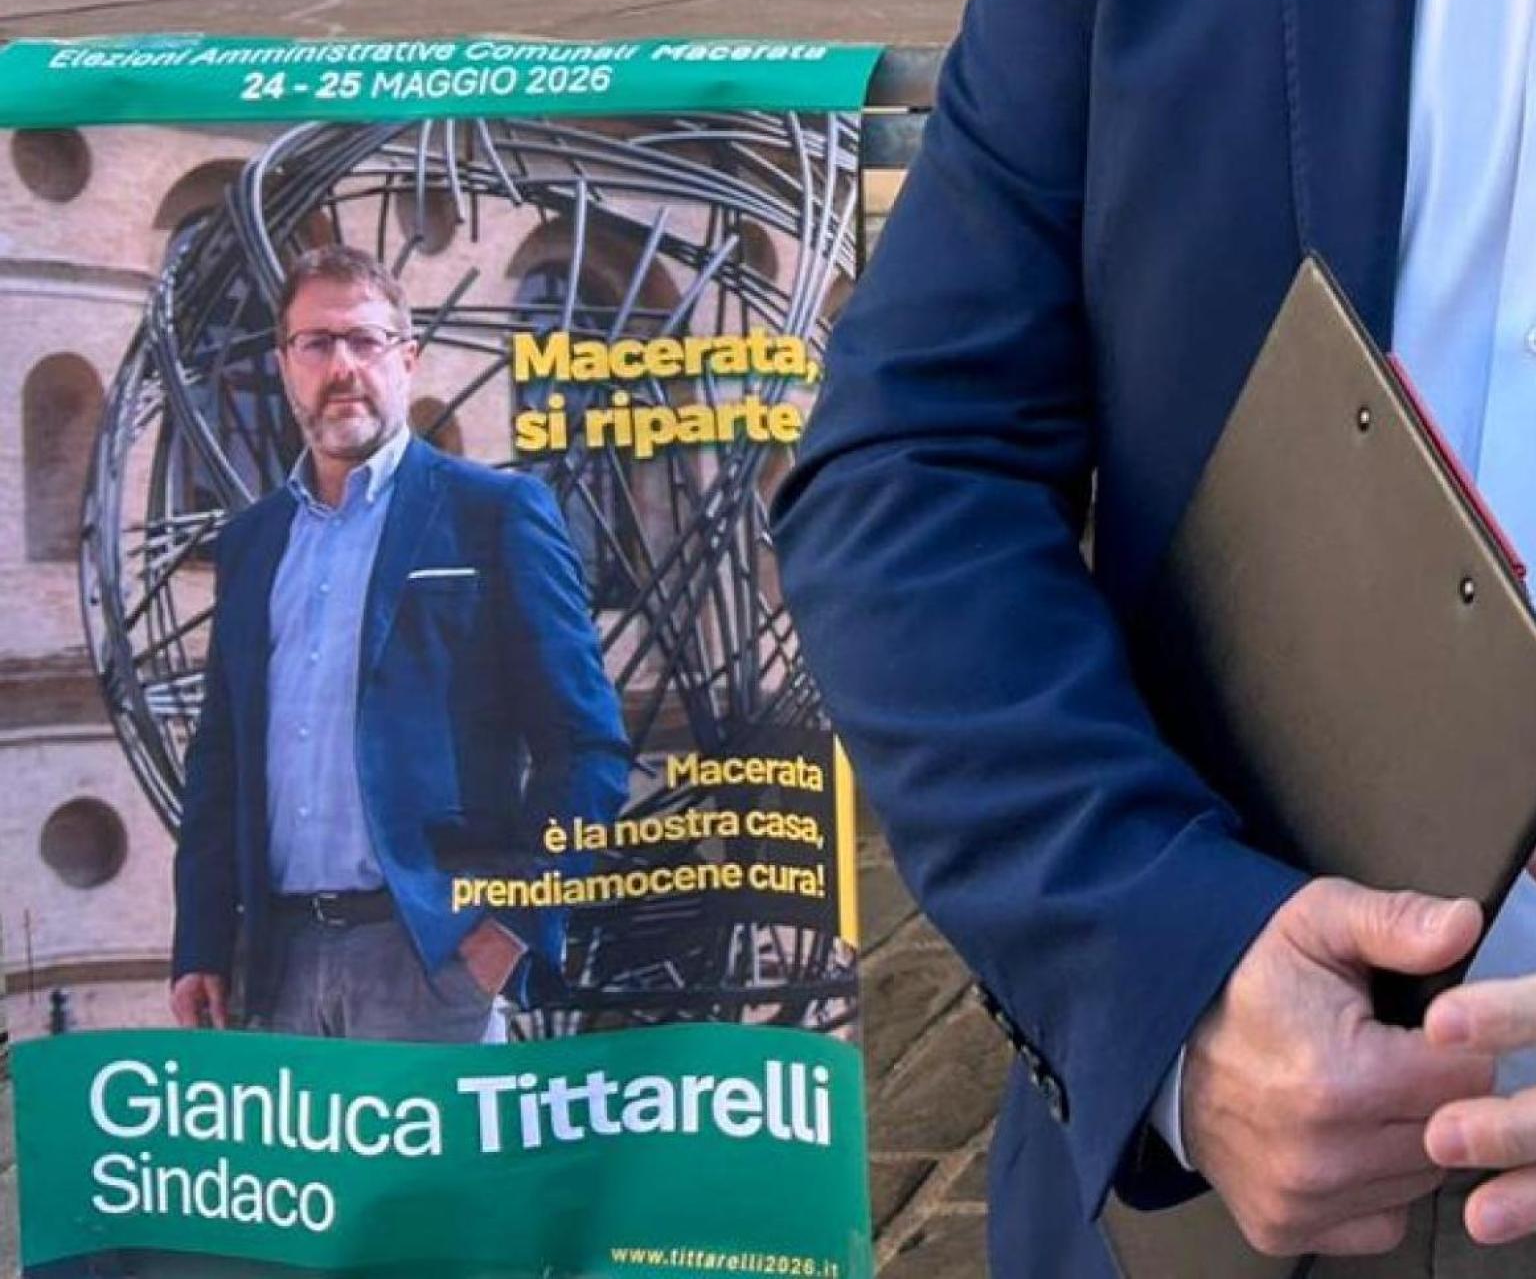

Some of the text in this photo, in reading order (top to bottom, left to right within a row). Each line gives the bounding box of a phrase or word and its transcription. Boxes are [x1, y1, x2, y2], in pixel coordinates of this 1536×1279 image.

[47, 39, 828, 69] Elezioni Amministrative Comunali Macerata
[239, 71, 286, 102] 24
[313, 69, 362, 100] 25
[369, 66, 518, 99] MAGGIO
[524, 63, 614, 95] 2026
[512, 326, 824, 386] Macerata,
[514, 389, 804, 460] si riparte
[664, 751, 825, 793] Macerata
[542, 806, 826, 854] è la nostra casa,
[451, 860, 827, 915] prendiamocene cura!
[90, 1059, 833, 1159] Gianluca Tittarelli
[90, 1151, 337, 1234] Sindaco
